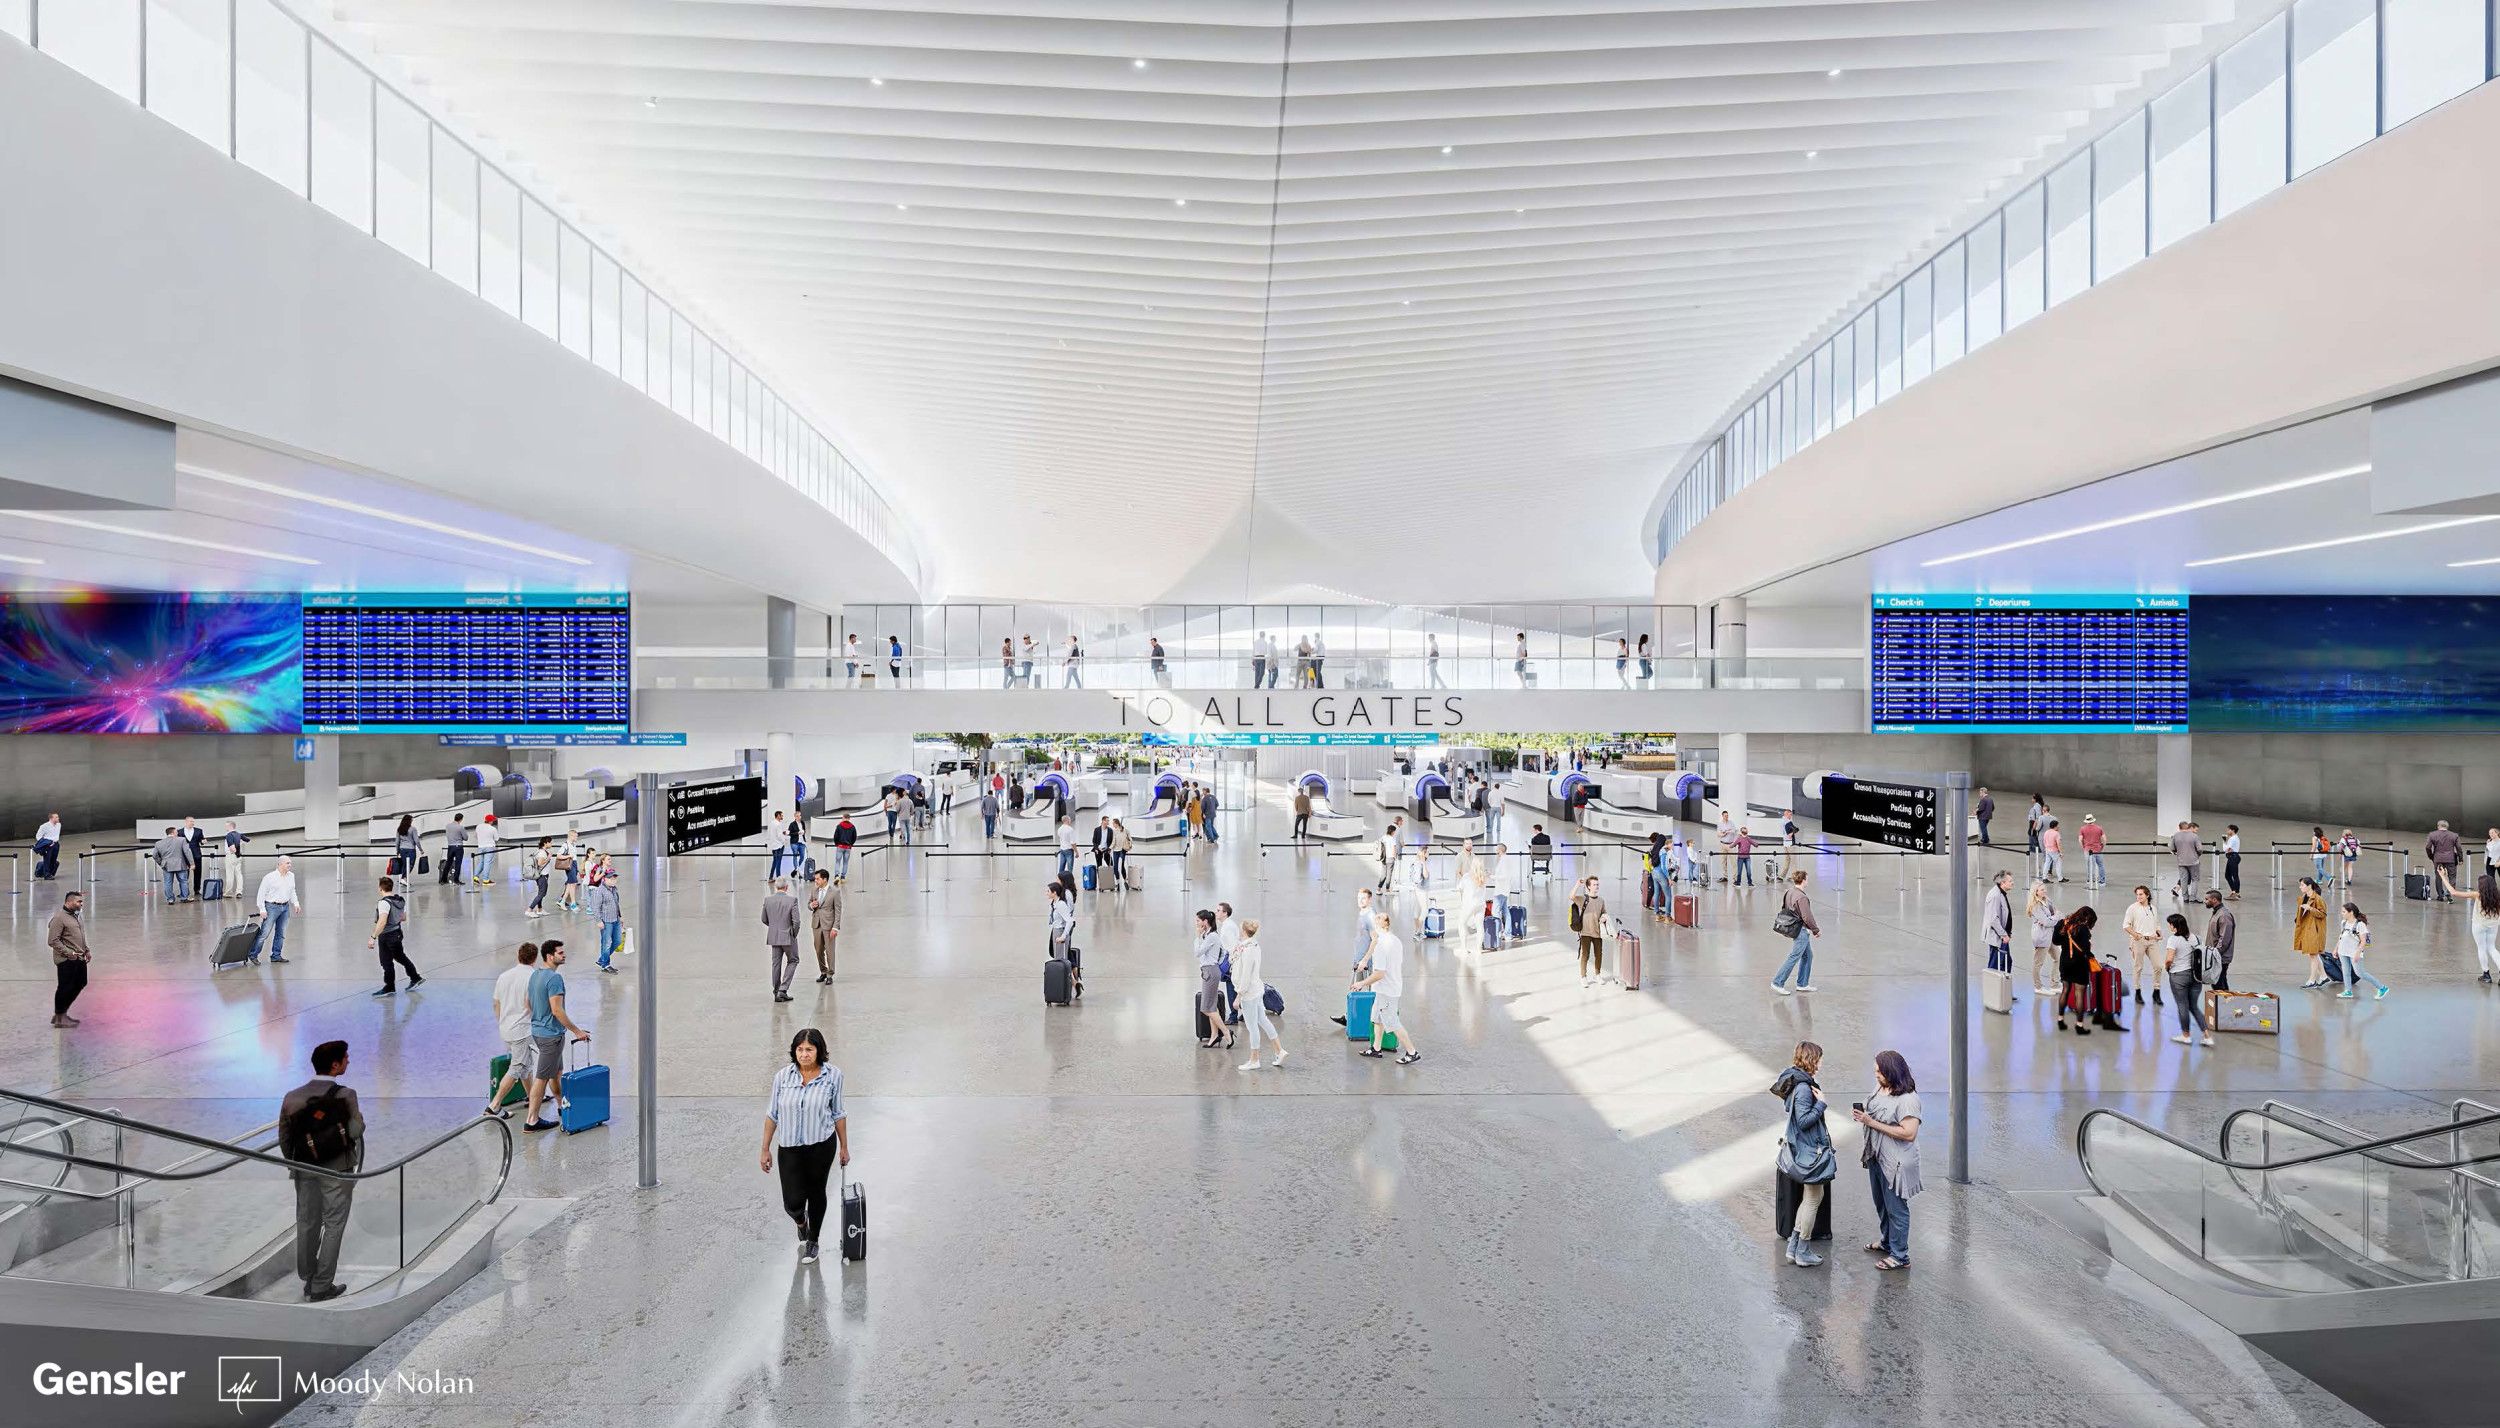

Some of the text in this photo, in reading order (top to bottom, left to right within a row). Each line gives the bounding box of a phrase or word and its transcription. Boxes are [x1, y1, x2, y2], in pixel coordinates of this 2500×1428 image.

[1889, 597, 1924, 607] Check-in
[2150, 598, 2179, 607] Arrivals
[1112, 696, 1464, 727] TO ALL GATES
